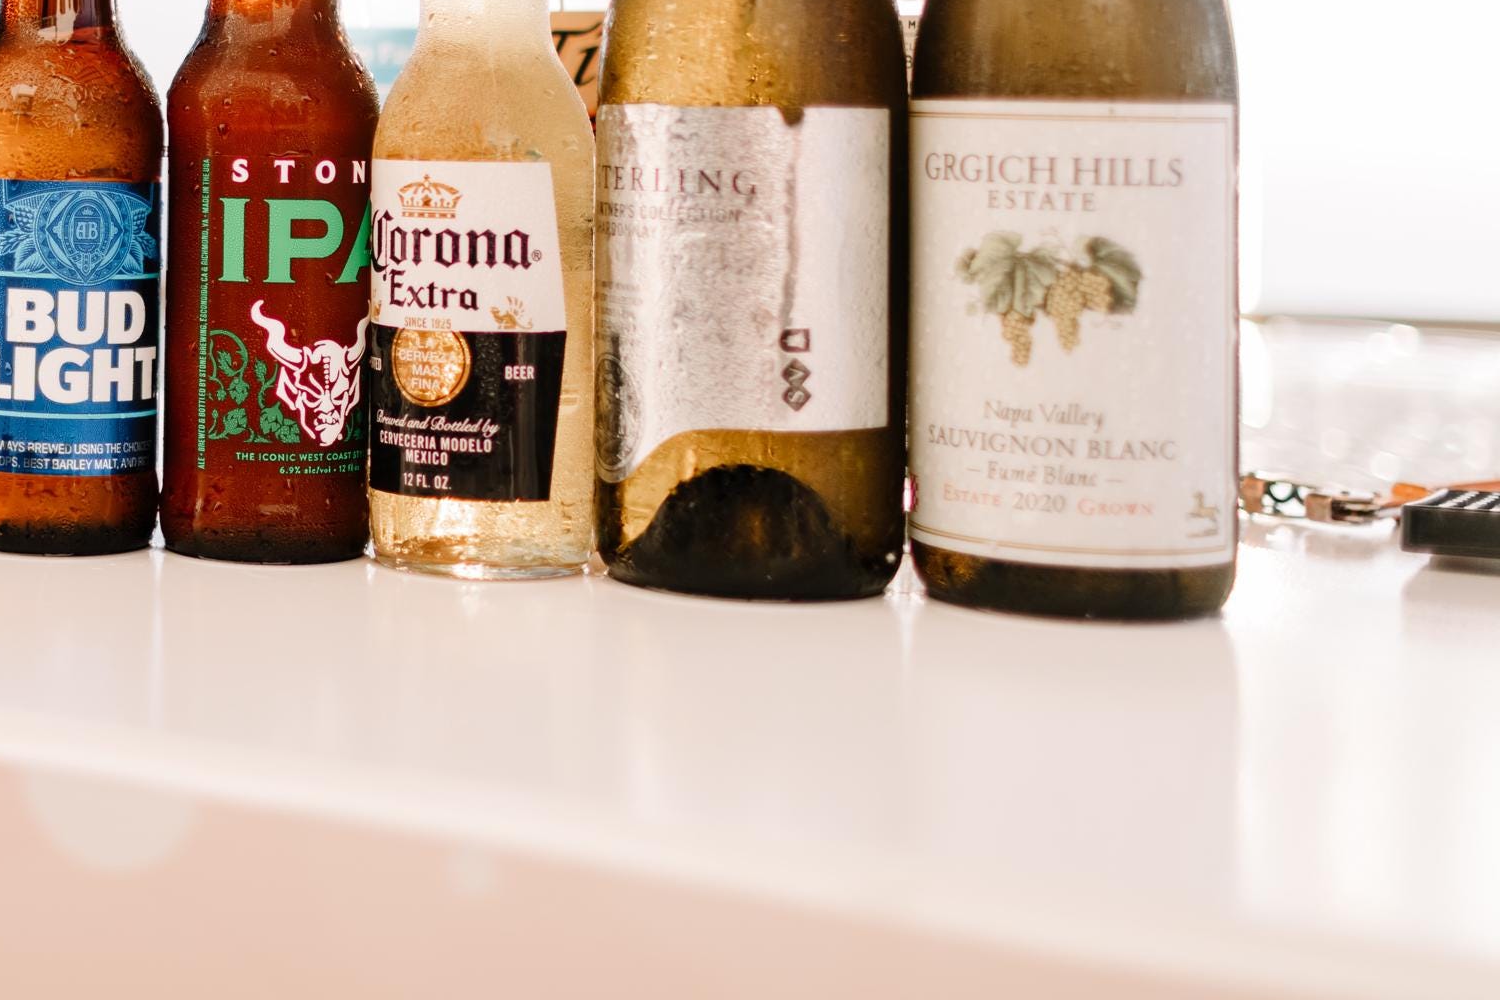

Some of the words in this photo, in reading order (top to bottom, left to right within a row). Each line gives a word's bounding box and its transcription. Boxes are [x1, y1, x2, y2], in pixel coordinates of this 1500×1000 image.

[232, 158, 366, 184] STON
[601, 165, 756, 196] TERLING
[925, 152, 1059, 186] GRGICH
[1072, 157, 1184, 187] HILLS
[987, 190, 1098, 212] ESTATE
[389, 269, 479, 311] Extra
[6, 288, 146, 345] BUD
[404, 316, 427, 329] SINCE
[504, 365, 535, 380] BEER
[376, 409, 406, 427] Brewed
[407, 415, 431, 429] and
[430, 415, 481, 433] Bottled
[482, 418, 499, 438] by
[984, 400, 1034, 428] Napa
[1039, 403, 1105, 433] Valley
[27, 442, 71, 454] BREWED
[74, 443, 104, 454] USING
[104, 442, 121, 454] THE
[379, 430, 436, 450] CERVECERIA
[440, 436, 492, 453] MODELO
[928, 424, 1076, 459] SAUVIGNON
[1087, 439, 1179, 461] BLANC
[24, 458, 50, 469] BEST
[52, 459, 92, 470] BARLEY
[236, 452, 255, 461] THE
[259, 453, 296, 462] ICONIC
[300, 453, 324, 461] WEST
[326, 452, 351, 461] COAST
[405, 449, 448, 466] MEXICO
[280, 466, 301, 474] 6.9%
[403, 472, 413, 486] 12
[1043, 465, 1098, 487] Blanc
[1012, 492, 1067, 514] 2020
